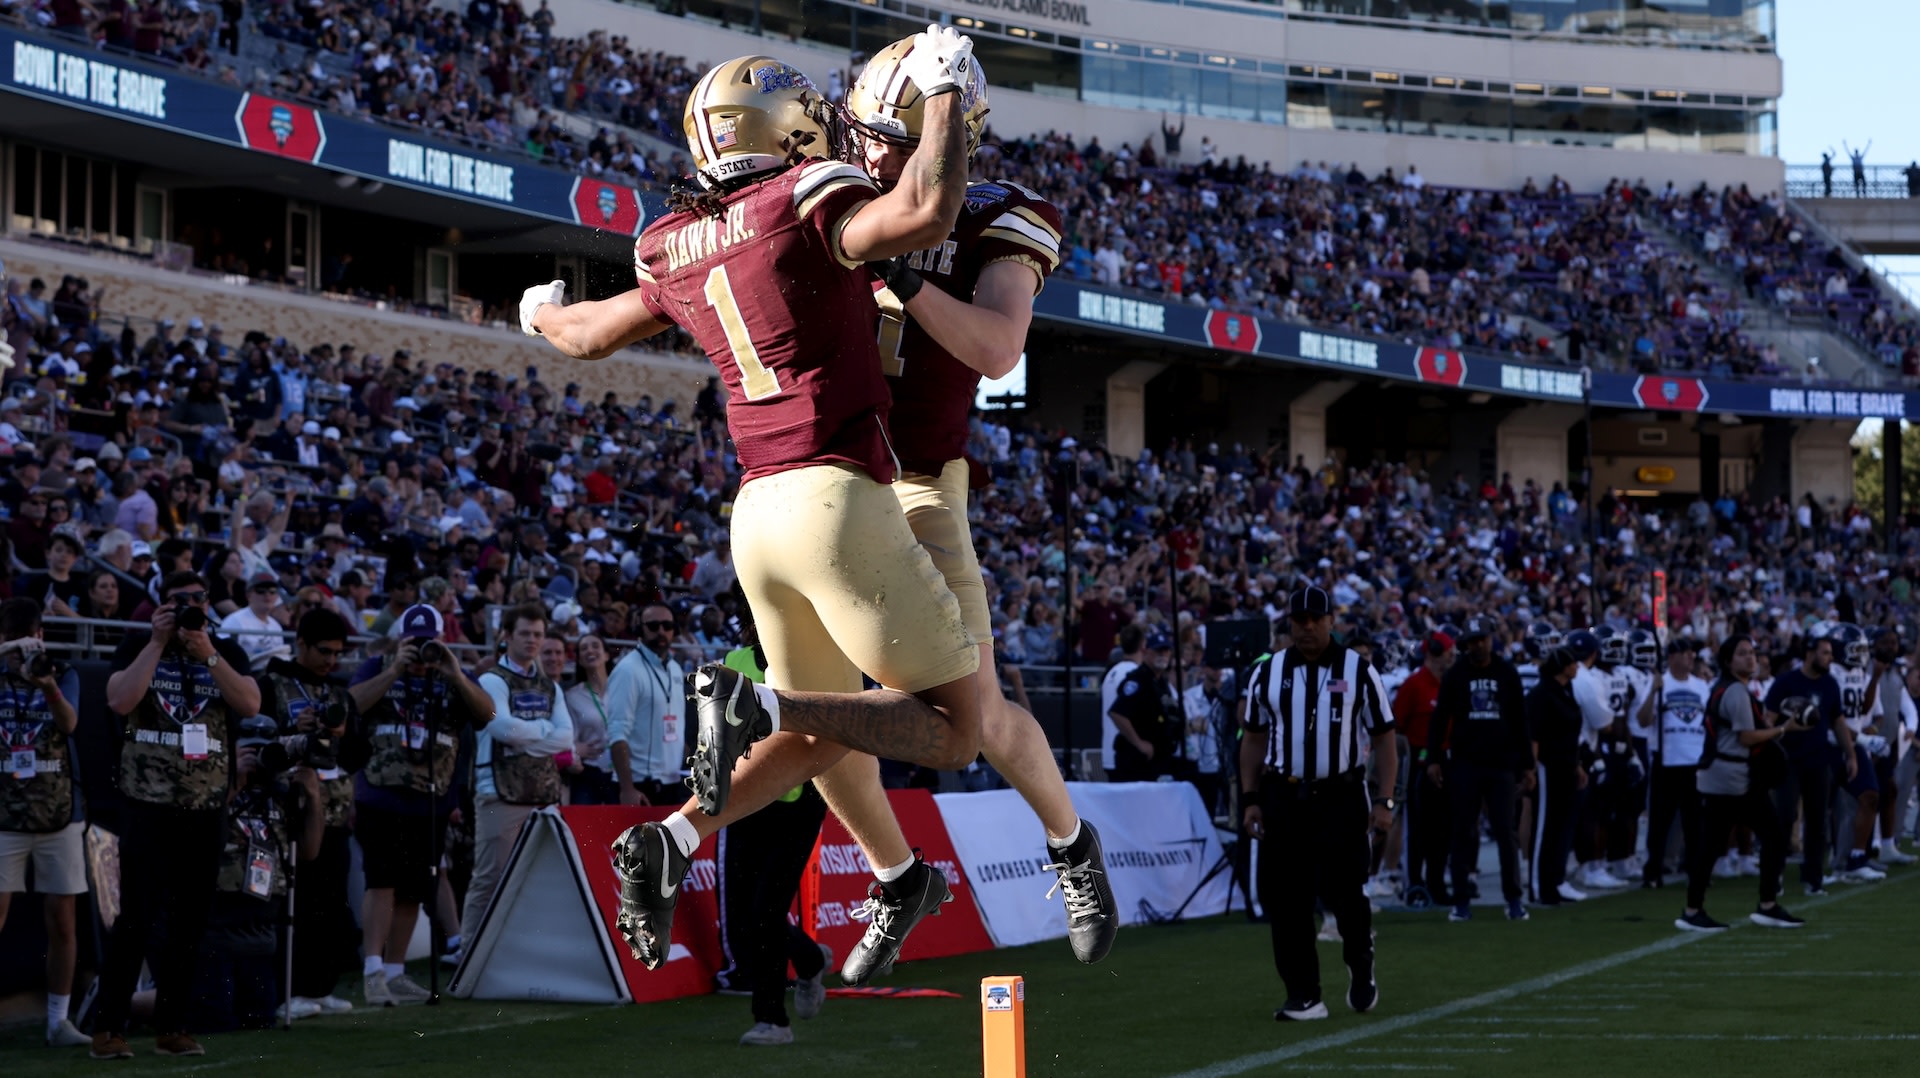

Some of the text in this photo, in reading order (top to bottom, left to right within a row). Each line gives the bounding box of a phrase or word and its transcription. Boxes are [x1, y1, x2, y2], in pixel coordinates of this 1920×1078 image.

[1050, 1, 1091, 26] BOWL
[13, 40, 166, 119] BOWL FOR THE BRAVE
[872, 113, 899, 130] BOBCATS
[389, 138, 513, 202] BOWL FOR THE BRAVE
[719, 158, 756, 175] STATE
[665, 201, 755, 272] DAWN JR.
[907, 240, 958, 276] ATE
[1079, 290, 1165, 333] BOWL FOR THE BRAVE
[704, 263, 783, 401] 1
[1770, 388, 1905, 416] BOWL FOR THE BRAVE
[1469, 678, 1499, 694] RICE
[135, 728, 160, 744] BOWL
[160, 731, 179, 746] FOR
[977, 859, 1036, 883] LOCKHEED
[1105, 848, 1193, 868] LOCKHEED MARTIN
